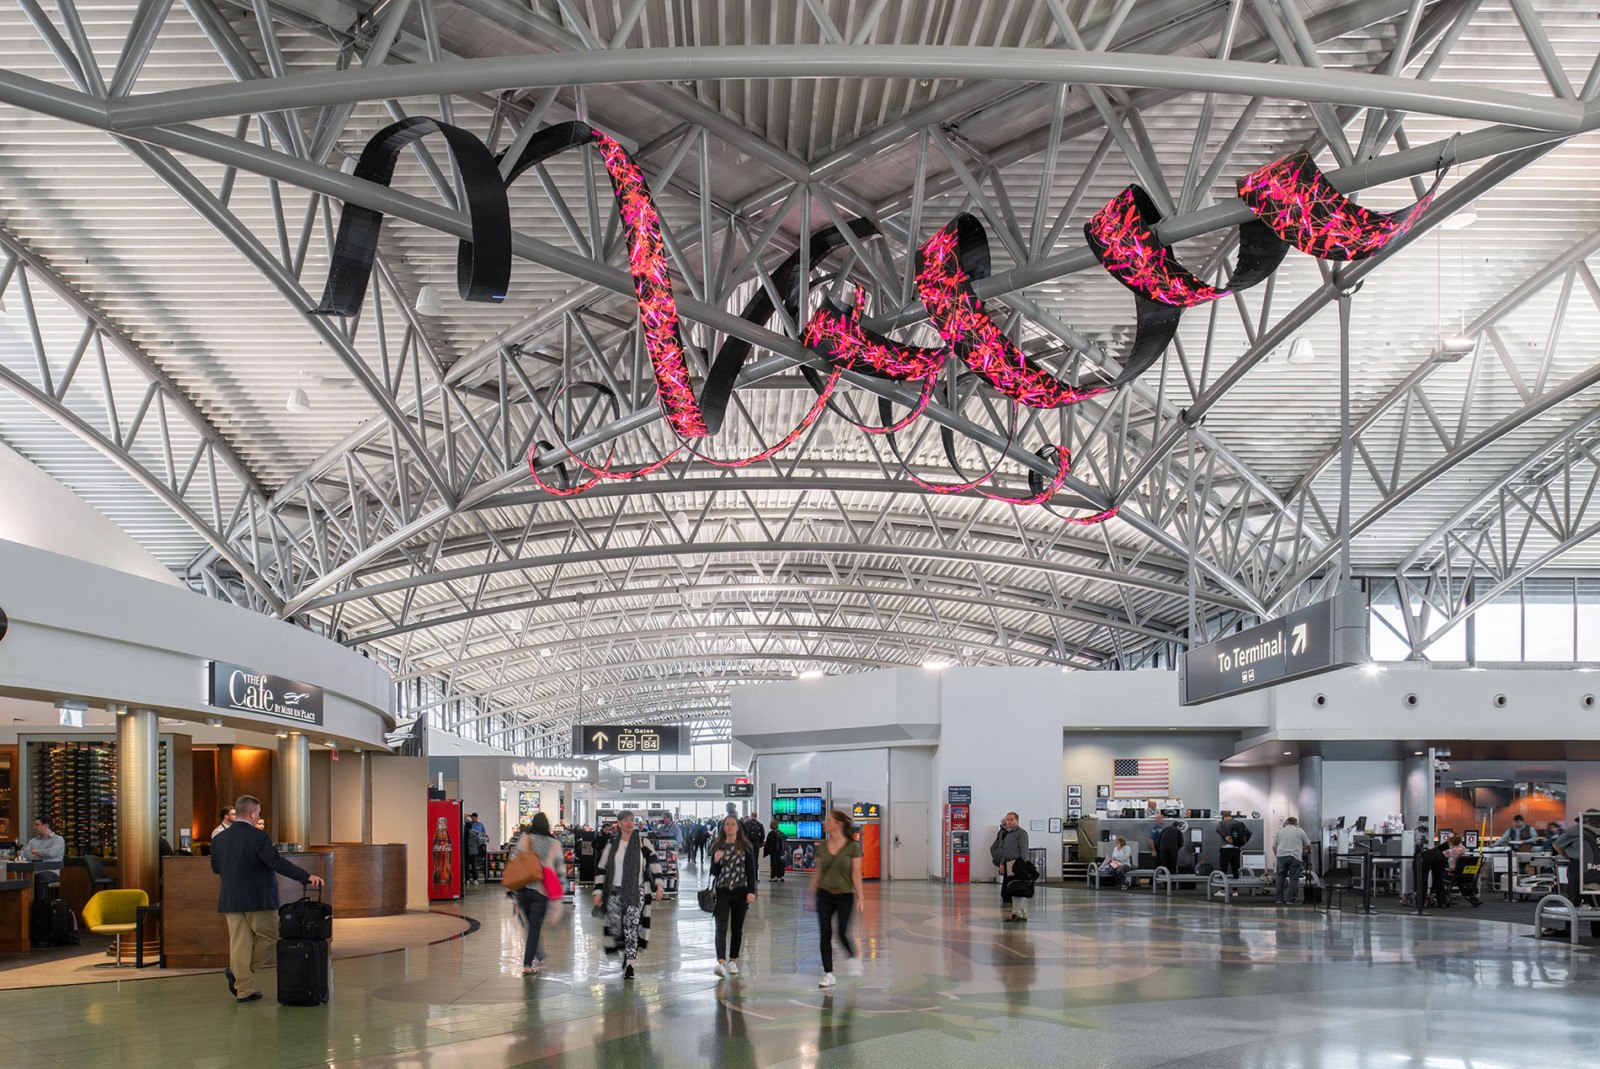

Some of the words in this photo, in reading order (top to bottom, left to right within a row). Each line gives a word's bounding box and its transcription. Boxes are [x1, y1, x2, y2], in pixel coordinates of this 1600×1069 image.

[1218, 652, 1231, 673] To
[1232, 631, 1282, 668] Terminal
[245, 674, 260, 685] THE
[229, 669, 274, 711] Cafe
[301, 709, 315, 720] PLACE
[620, 740, 634, 749] 76
[643, 740, 657, 749] 84
